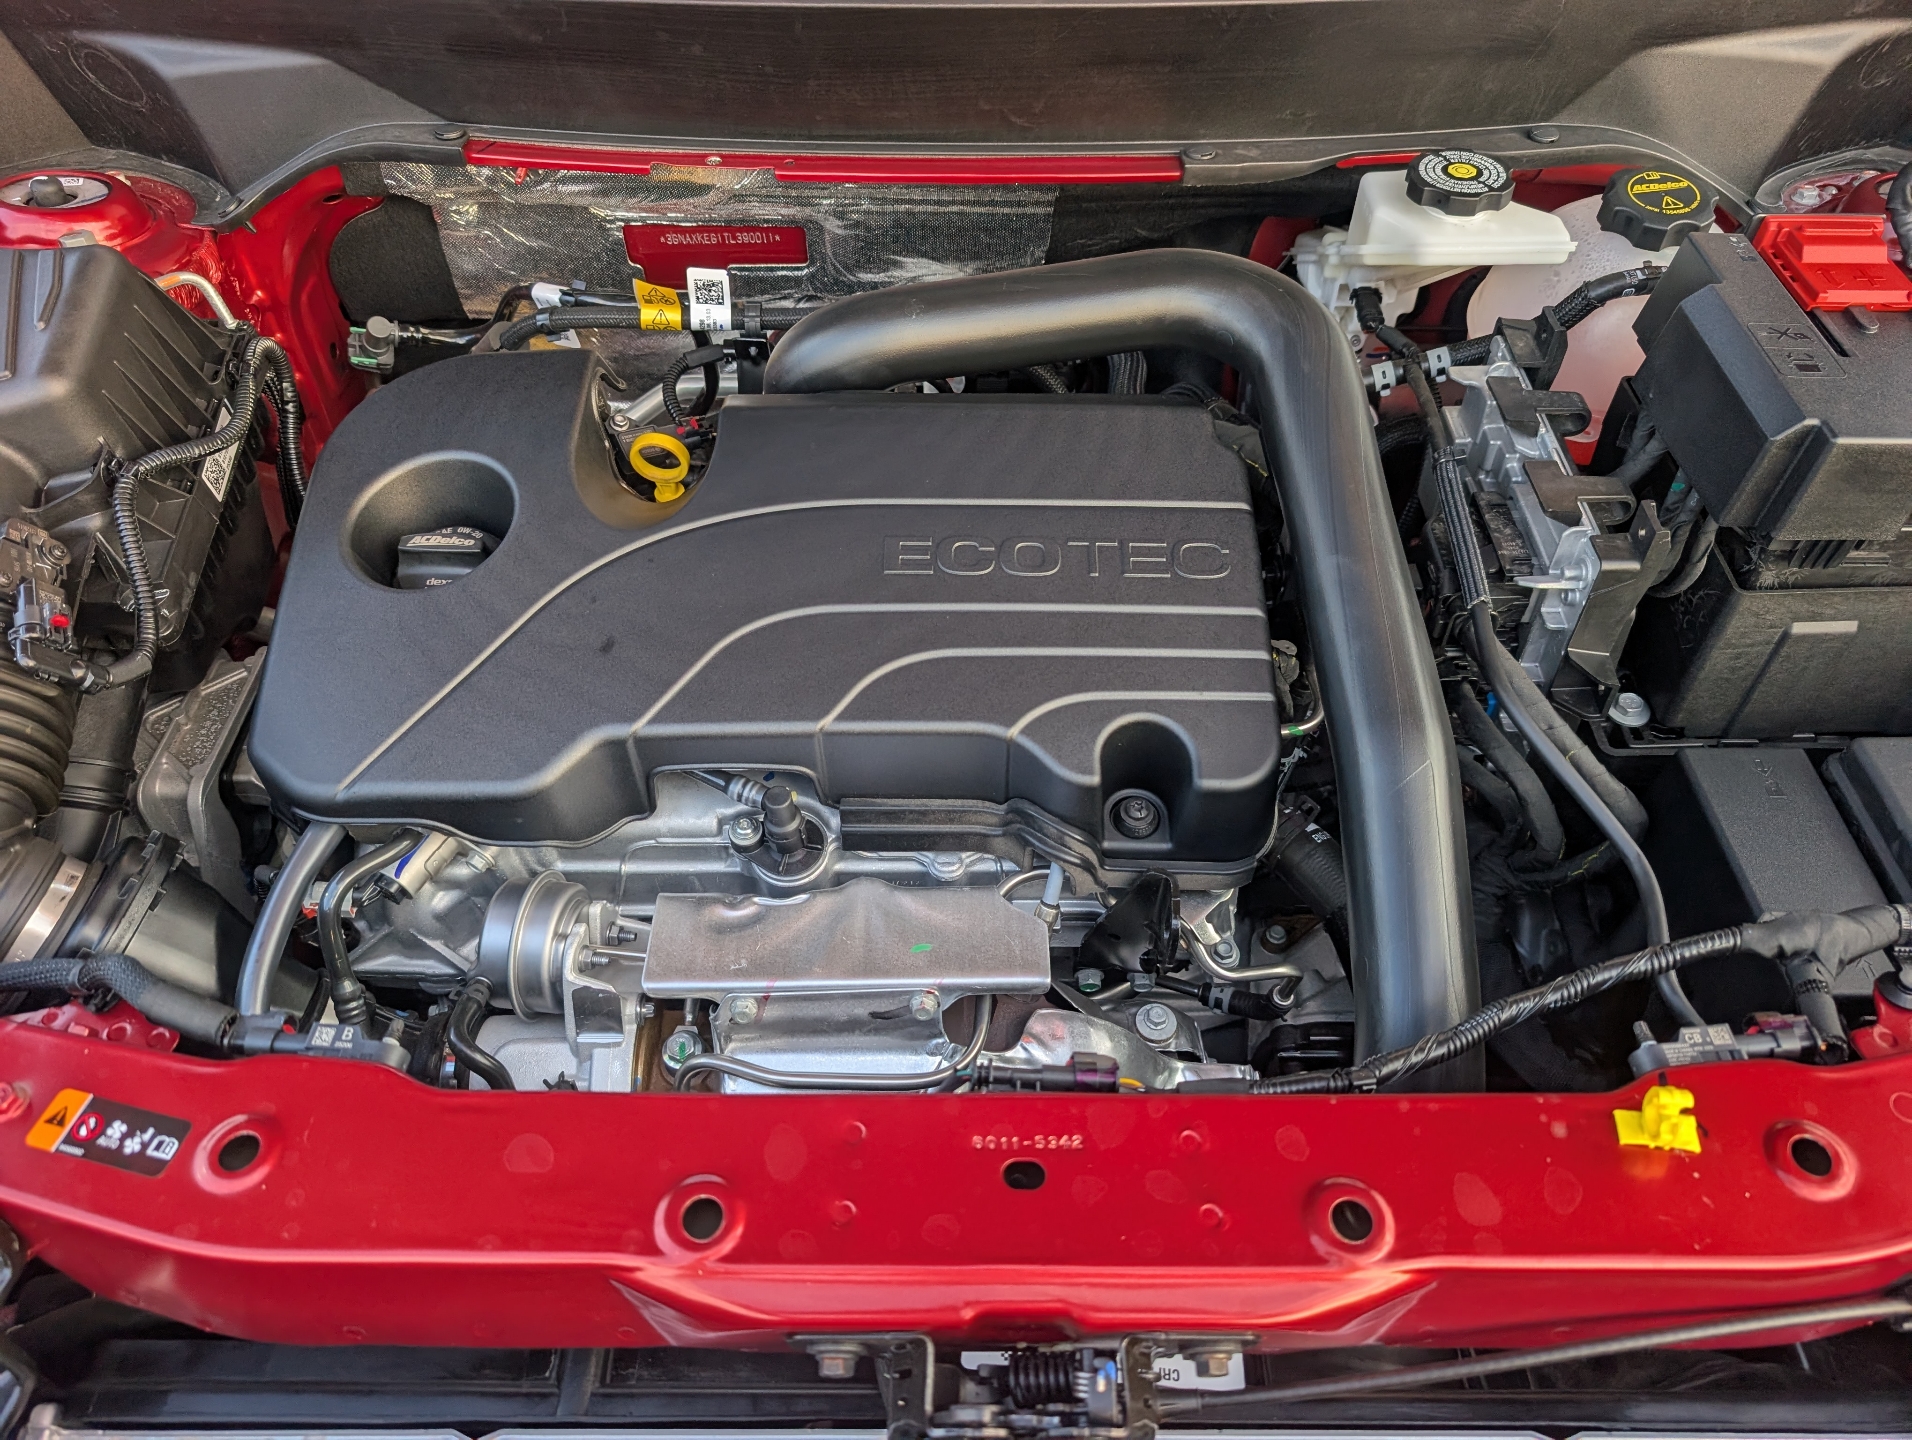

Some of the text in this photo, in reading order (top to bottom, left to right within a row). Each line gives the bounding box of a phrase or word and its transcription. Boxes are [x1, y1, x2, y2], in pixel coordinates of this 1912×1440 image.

[1632, 181, 1689, 193] ACDelco
[436, 526, 485, 539] AE 0W-20
[406, 535, 476, 547] ACDelco
[883, 535, 1232, 580] ECOTEC
[341, 1026, 354, 1041] B
[1684, 1033, 1703, 1044] CB
